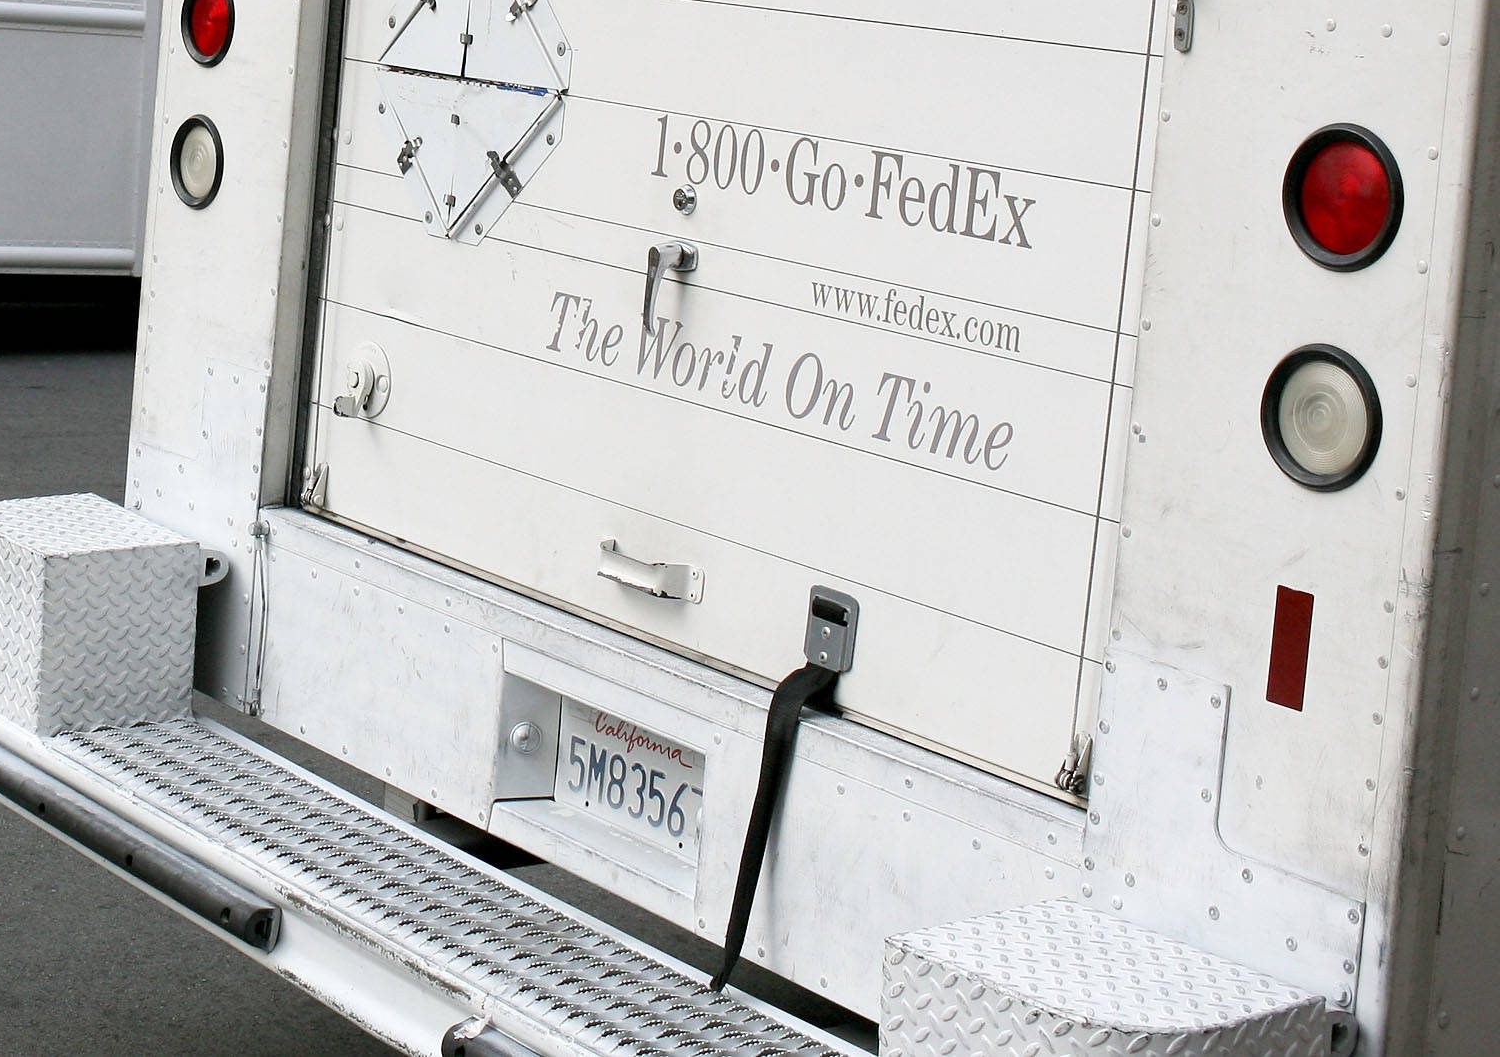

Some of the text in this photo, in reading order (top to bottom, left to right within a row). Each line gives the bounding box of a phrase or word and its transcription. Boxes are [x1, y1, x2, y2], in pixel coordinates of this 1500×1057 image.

[811, 279, 1021, 353] www.fedex.com
[546, 290, 1015, 471] The World On Time
[595, 712, 693, 769] California
